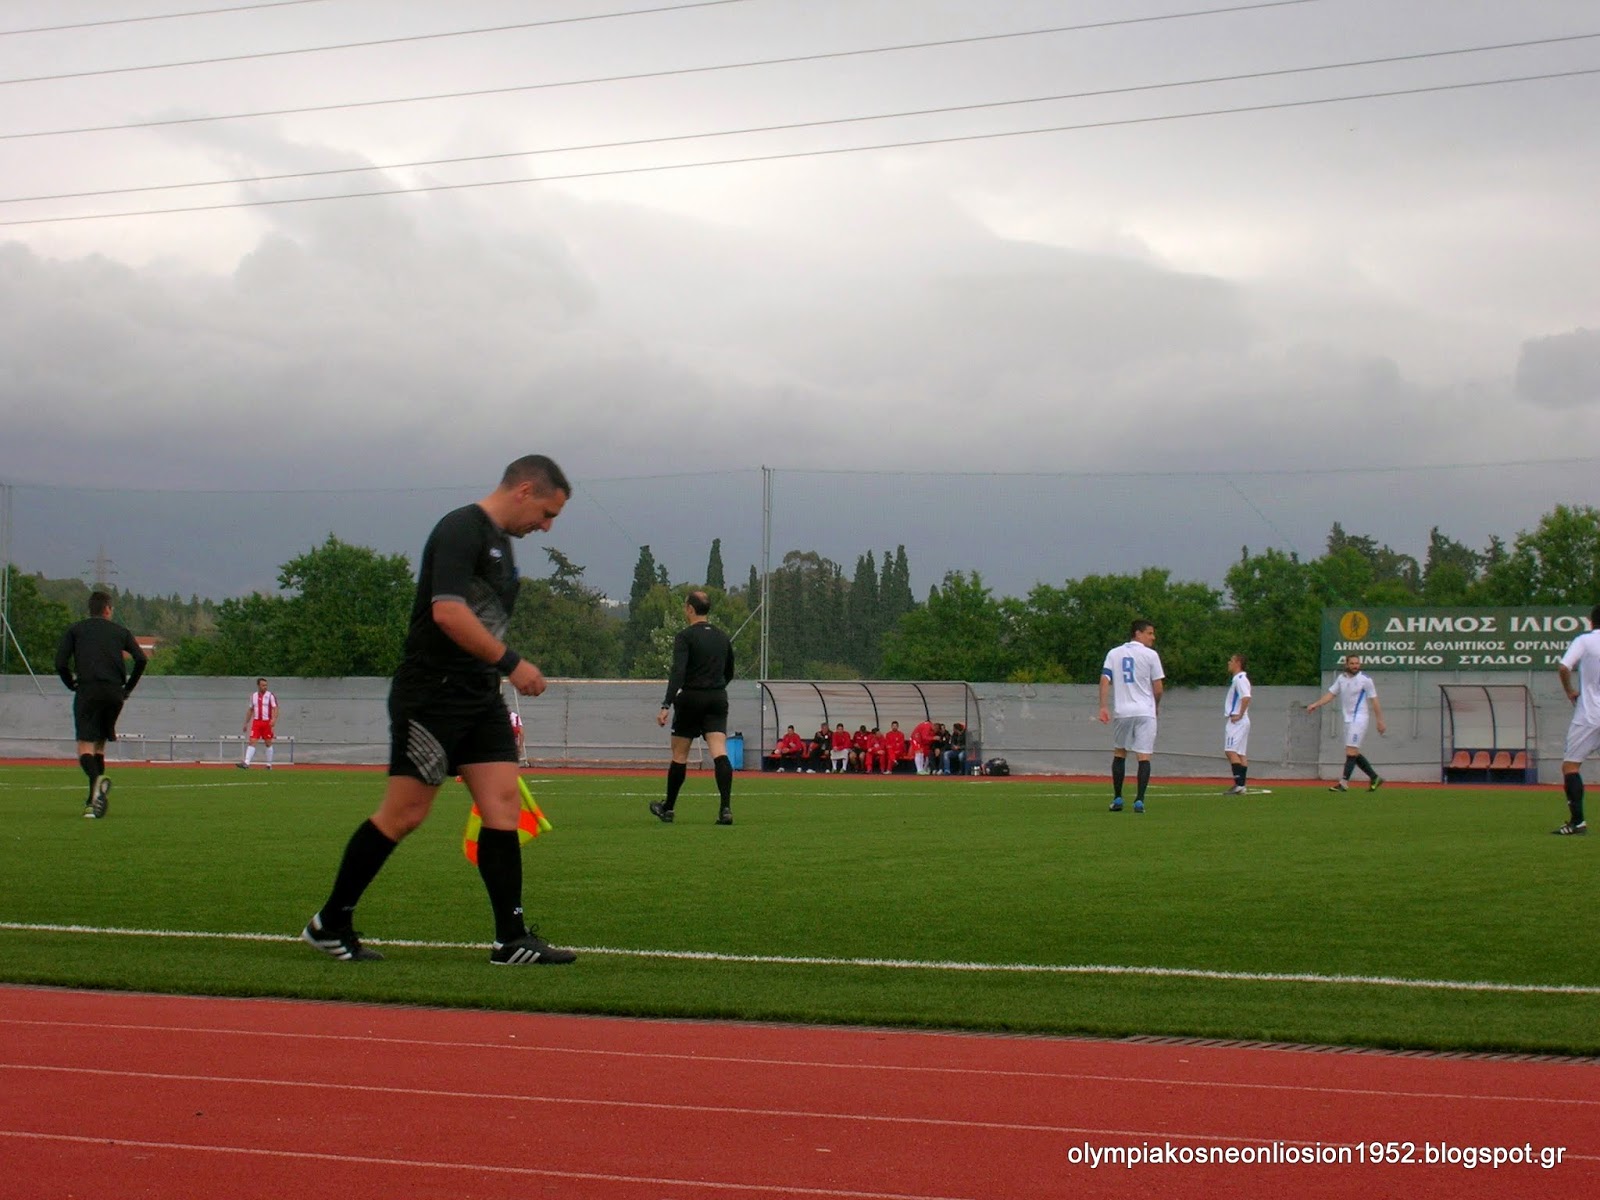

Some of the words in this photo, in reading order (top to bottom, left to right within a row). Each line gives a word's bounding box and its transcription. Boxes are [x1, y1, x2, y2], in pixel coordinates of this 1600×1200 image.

[1385, 616, 1498, 633] ΔΗΜΟΣ
[1333, 641, 1415, 651] ΔΗΜΟΤΙΚΟΣ
[1424, 641, 1506, 651] ΑΘΛΗΤΙΚΟΣ
[1337, 655, 1443, 665] ΔΜΟΤΙΚΟ
[1459, 655, 1532, 665] ΣΤΑΔΙΟ
[1122, 656, 1135, 683] 9
